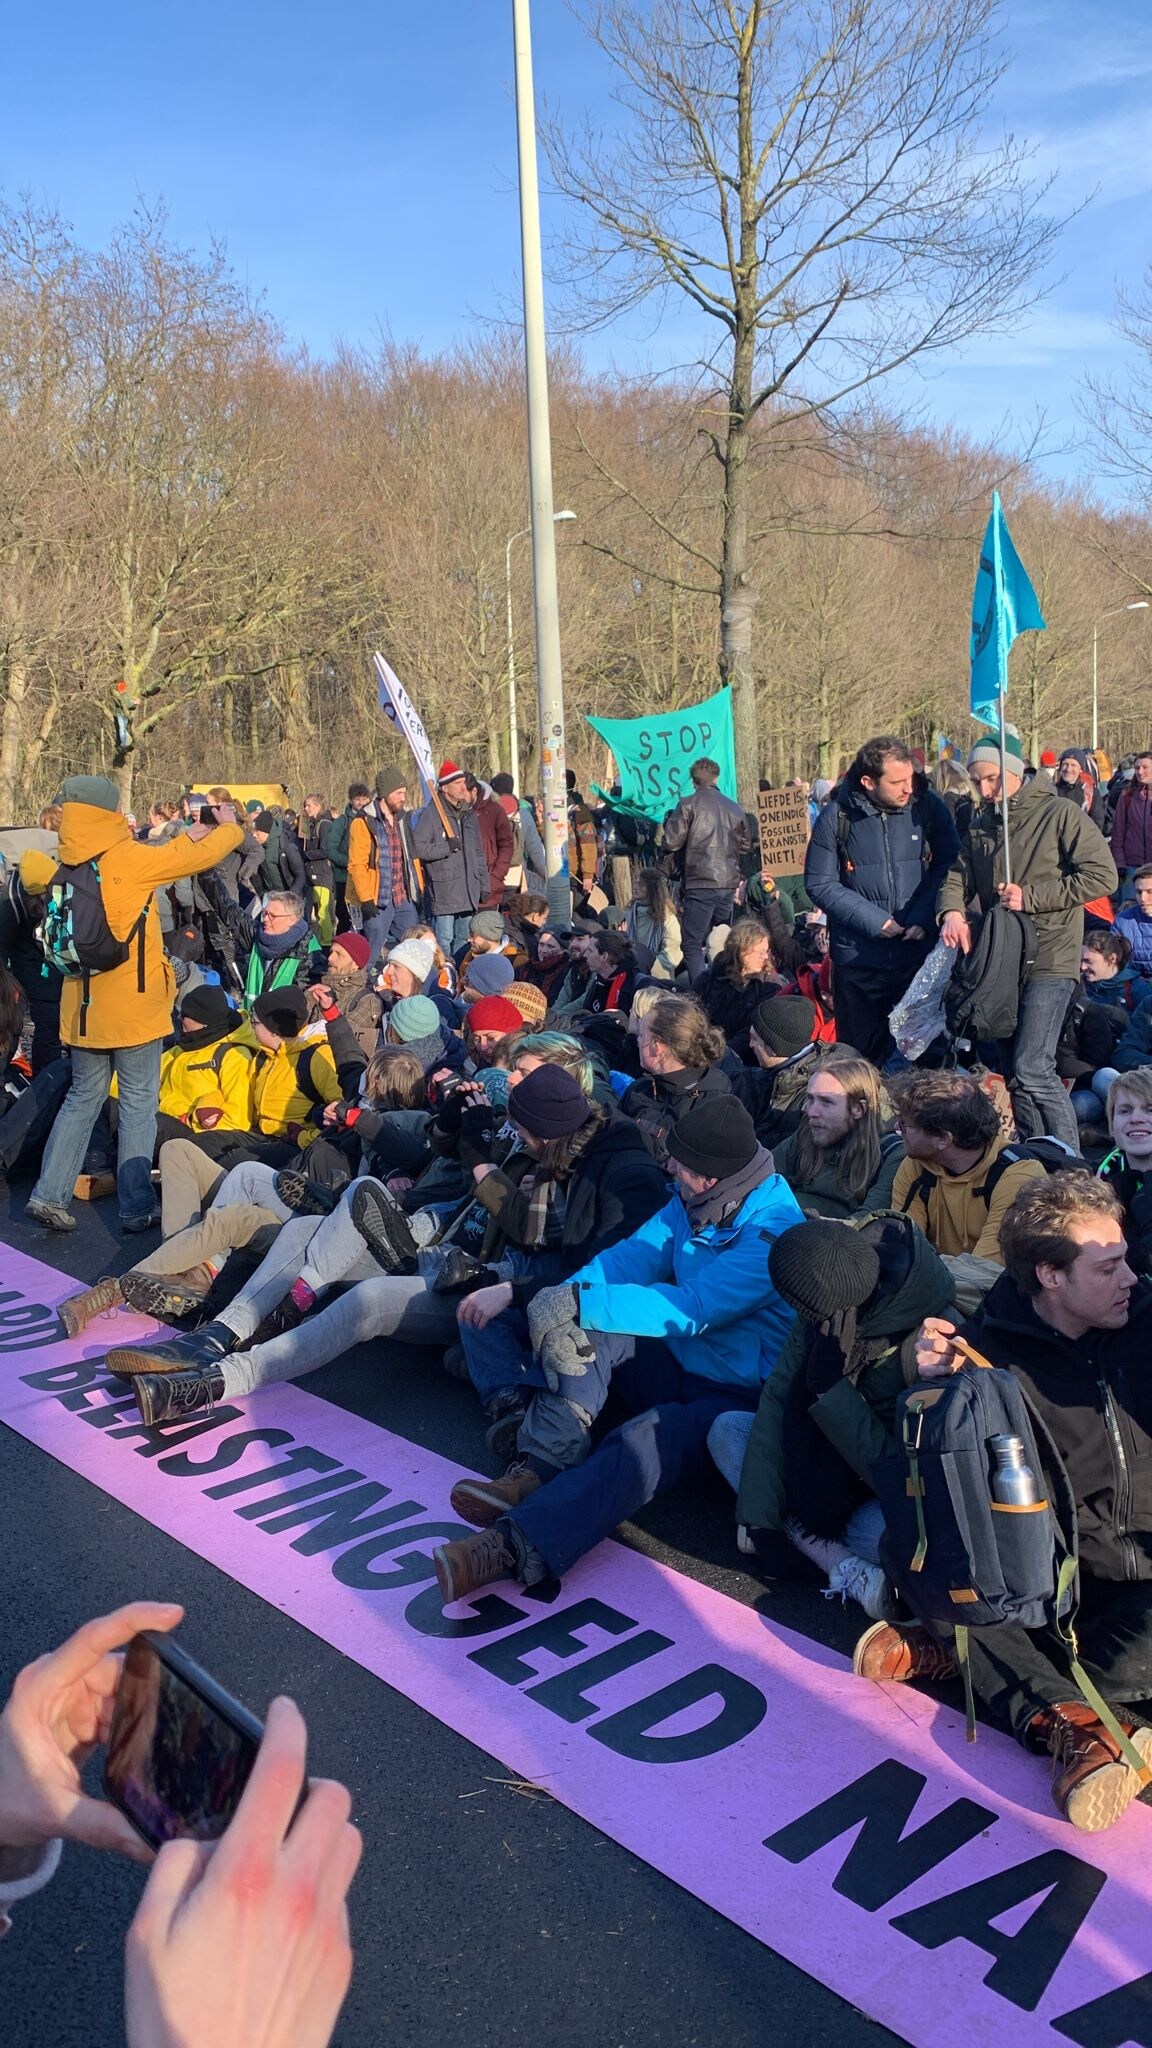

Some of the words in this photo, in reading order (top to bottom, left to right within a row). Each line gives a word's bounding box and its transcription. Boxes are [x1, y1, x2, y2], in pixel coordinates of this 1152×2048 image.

[638, 722, 712, 760] STOP
[757, 793, 791, 809] LIEFDE
[793, 790, 804, 805] IS
[760, 807, 805, 824] ONEINDIG
[761, 823, 801, 837] FOSSIELE
[762, 833, 807, 849] BRANDSTOF
[763, 849, 796, 865] NIET!
